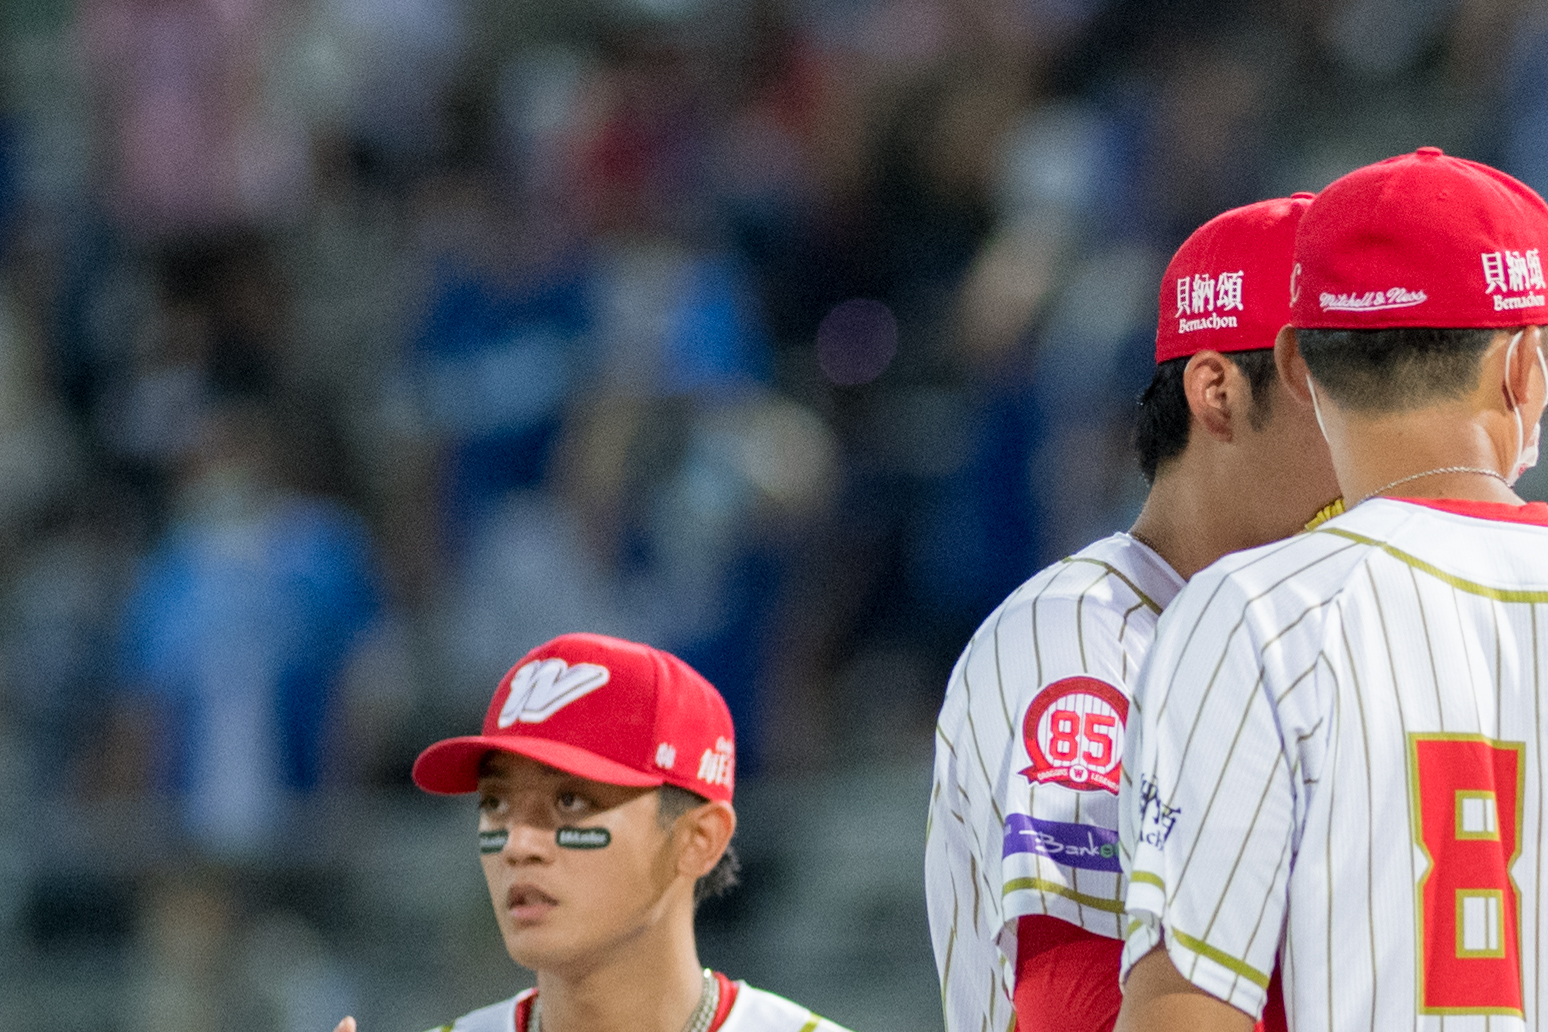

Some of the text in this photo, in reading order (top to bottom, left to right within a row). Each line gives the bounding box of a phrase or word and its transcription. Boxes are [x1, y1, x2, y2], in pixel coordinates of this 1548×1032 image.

[1175, 269, 1244, 318] 貝納頌
[1178, 312, 1239, 334] Bernachon
[1049, 711, 1116, 767] 85
